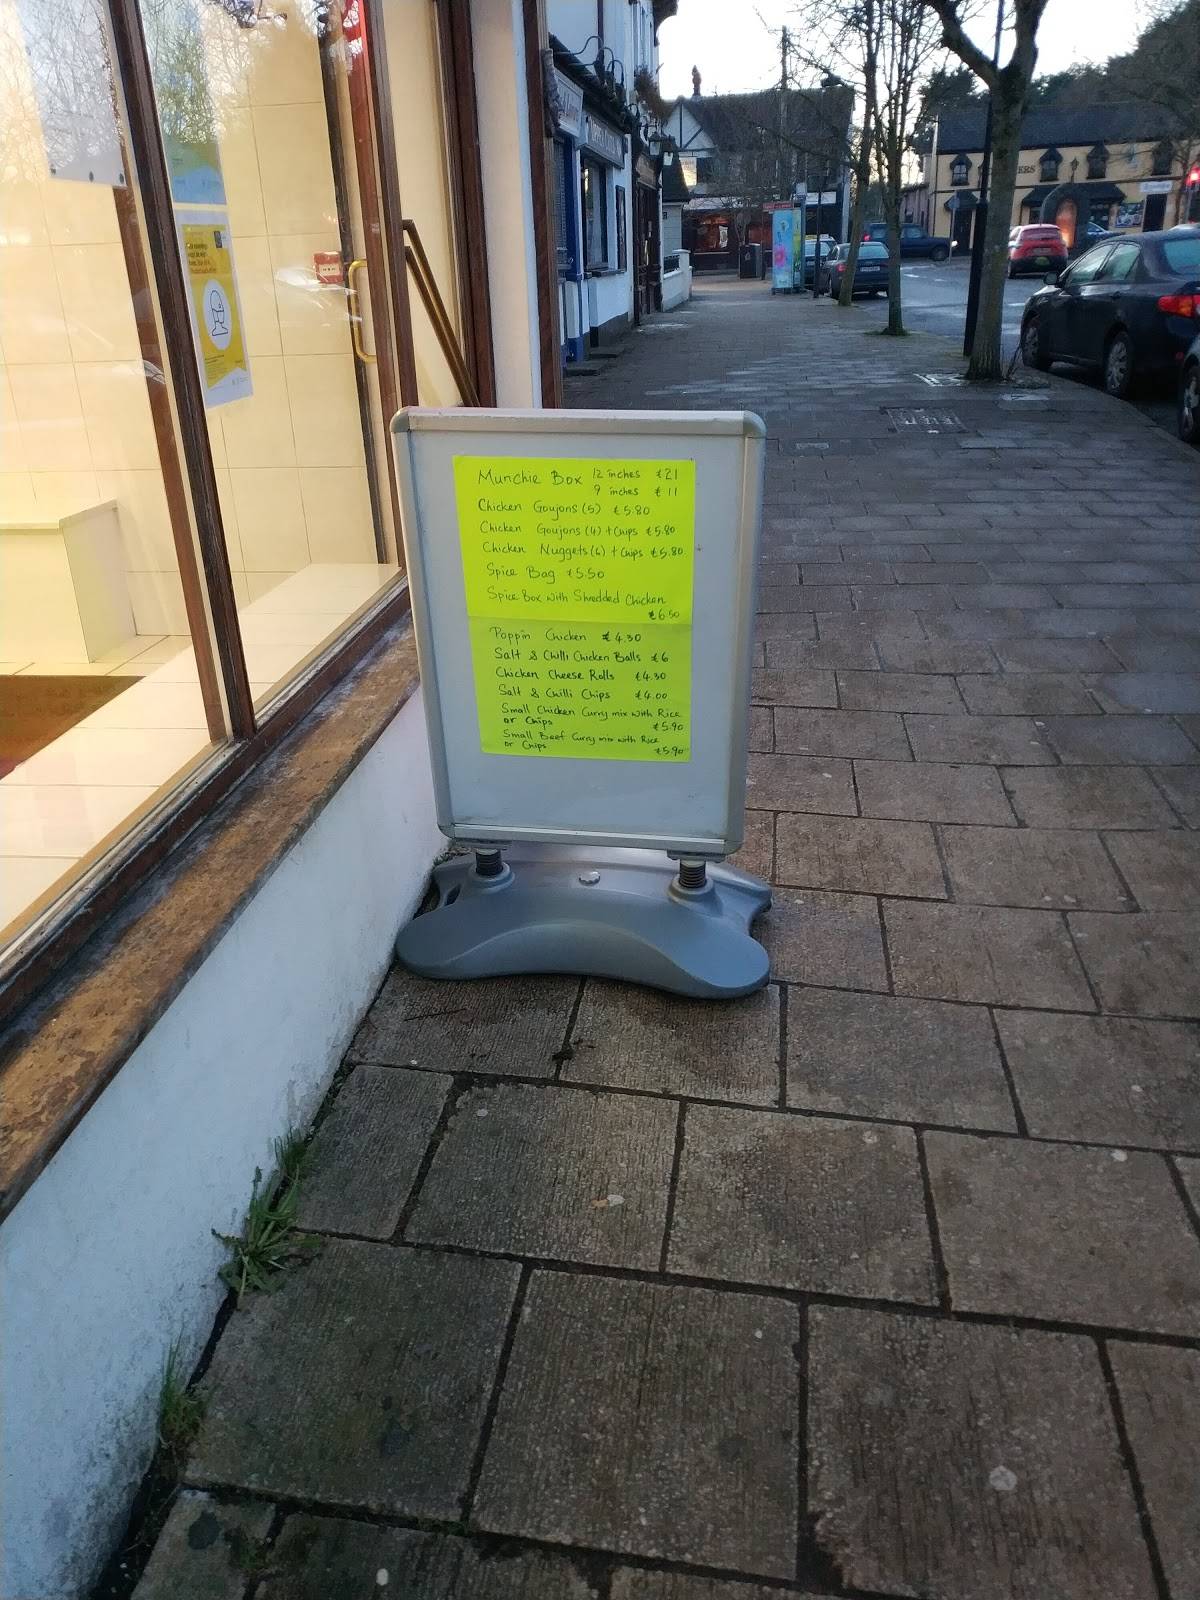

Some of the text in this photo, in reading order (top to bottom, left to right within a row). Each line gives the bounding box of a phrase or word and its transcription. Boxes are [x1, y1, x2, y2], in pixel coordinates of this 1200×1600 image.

[478, 468, 542, 486] Munchie
[551, 470, 582, 485] Box
[593, 467, 603, 479] 12
[607, 468, 640, 479] inches
[593, 484, 601, 496] 9
[609, 487, 639, 496] inches
[478, 498, 522, 512] Chicken
[480, 520, 522, 533] Chicken
[483, 541, 527, 553] Chicken
[487, 562, 518, 581] Spice
[526, 566, 556, 584] Bag
[487, 585, 666, 606] Spice Box with Shredded Chicken
[489, 626, 531, 646] Poppin
[545, 628, 587, 641] Chicken
[494, 647, 520, 660] Salt
[528, 650, 538, 660] &
[543, 649, 569, 661] Chilli
[573, 650, 609, 662] Chicken
[613, 650, 641, 663] Balls
[495, 666, 540, 680] Chicken
[548, 669, 584, 680] Cheese
[589, 669, 615, 681] Rolls
[498, 683, 521, 696] Salt
[530, 688, 540, 698] &
[545, 687, 573, 698] Chilli
[581, 689, 611, 702] Chips
[501, 702, 681, 721] Small Chicken Curry mix with Rice
[525, 716, 553, 730] Chips
[503, 728, 533, 740] Small
[539, 730, 566, 741] Beef
[617, 735, 636, 743] with
[641, 735, 660, 744] Rice
[521, 740, 548, 752] Chips
